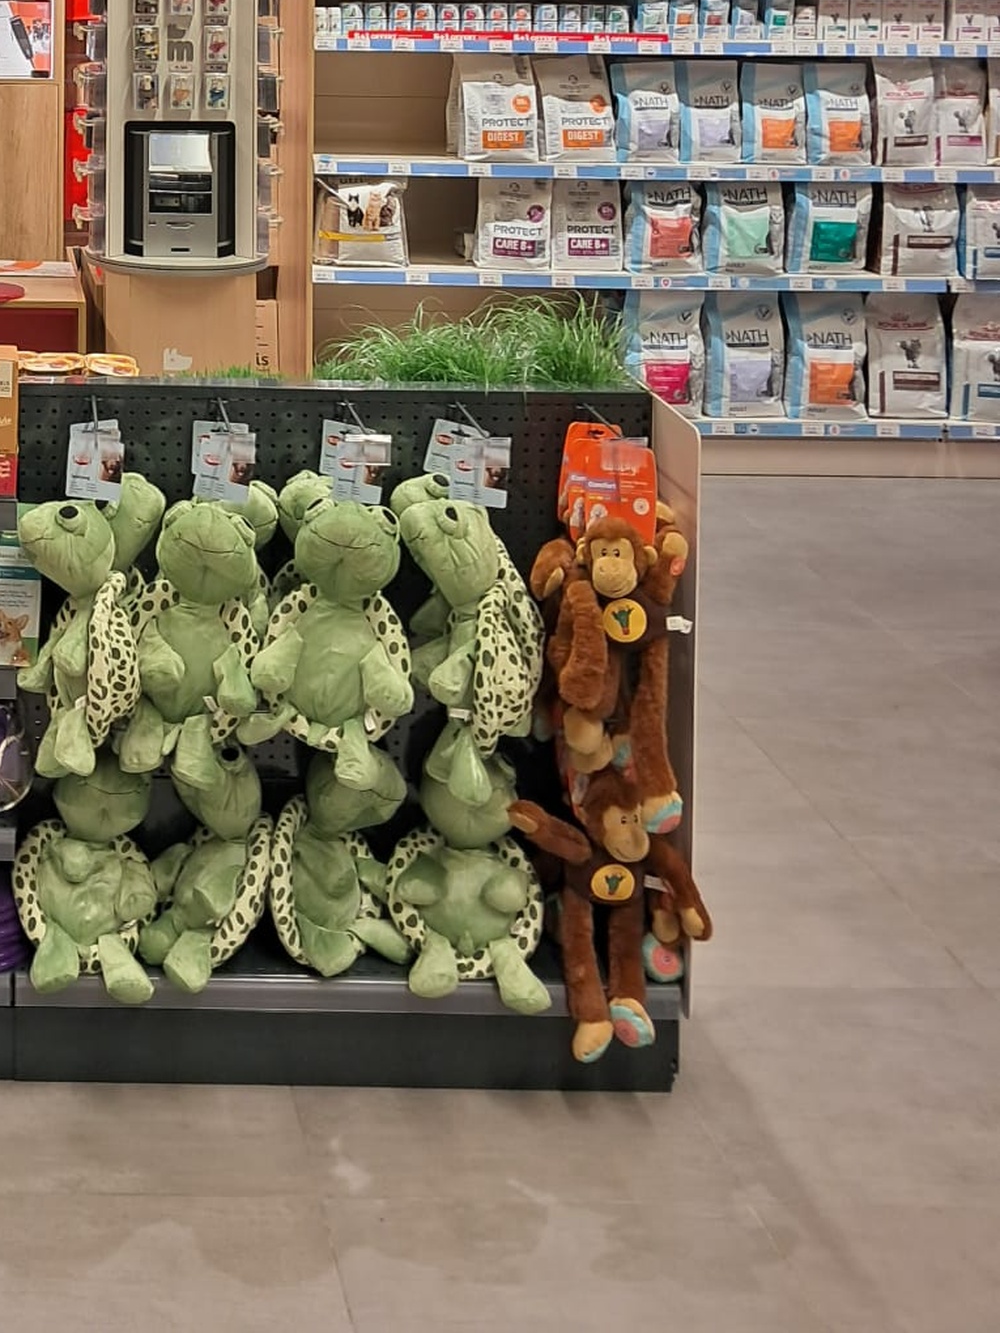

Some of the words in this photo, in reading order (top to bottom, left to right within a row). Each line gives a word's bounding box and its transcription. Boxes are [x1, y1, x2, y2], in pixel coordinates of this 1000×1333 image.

[482, 118, 530, 127] PROTECT
[561, 117, 608, 126] PROTECT
[487, 132, 519, 141] DIGEST
[567, 131, 599, 140] DIGEST
[493, 224, 543, 237] PROTECT
[567, 225, 616, 235] PROTECT
